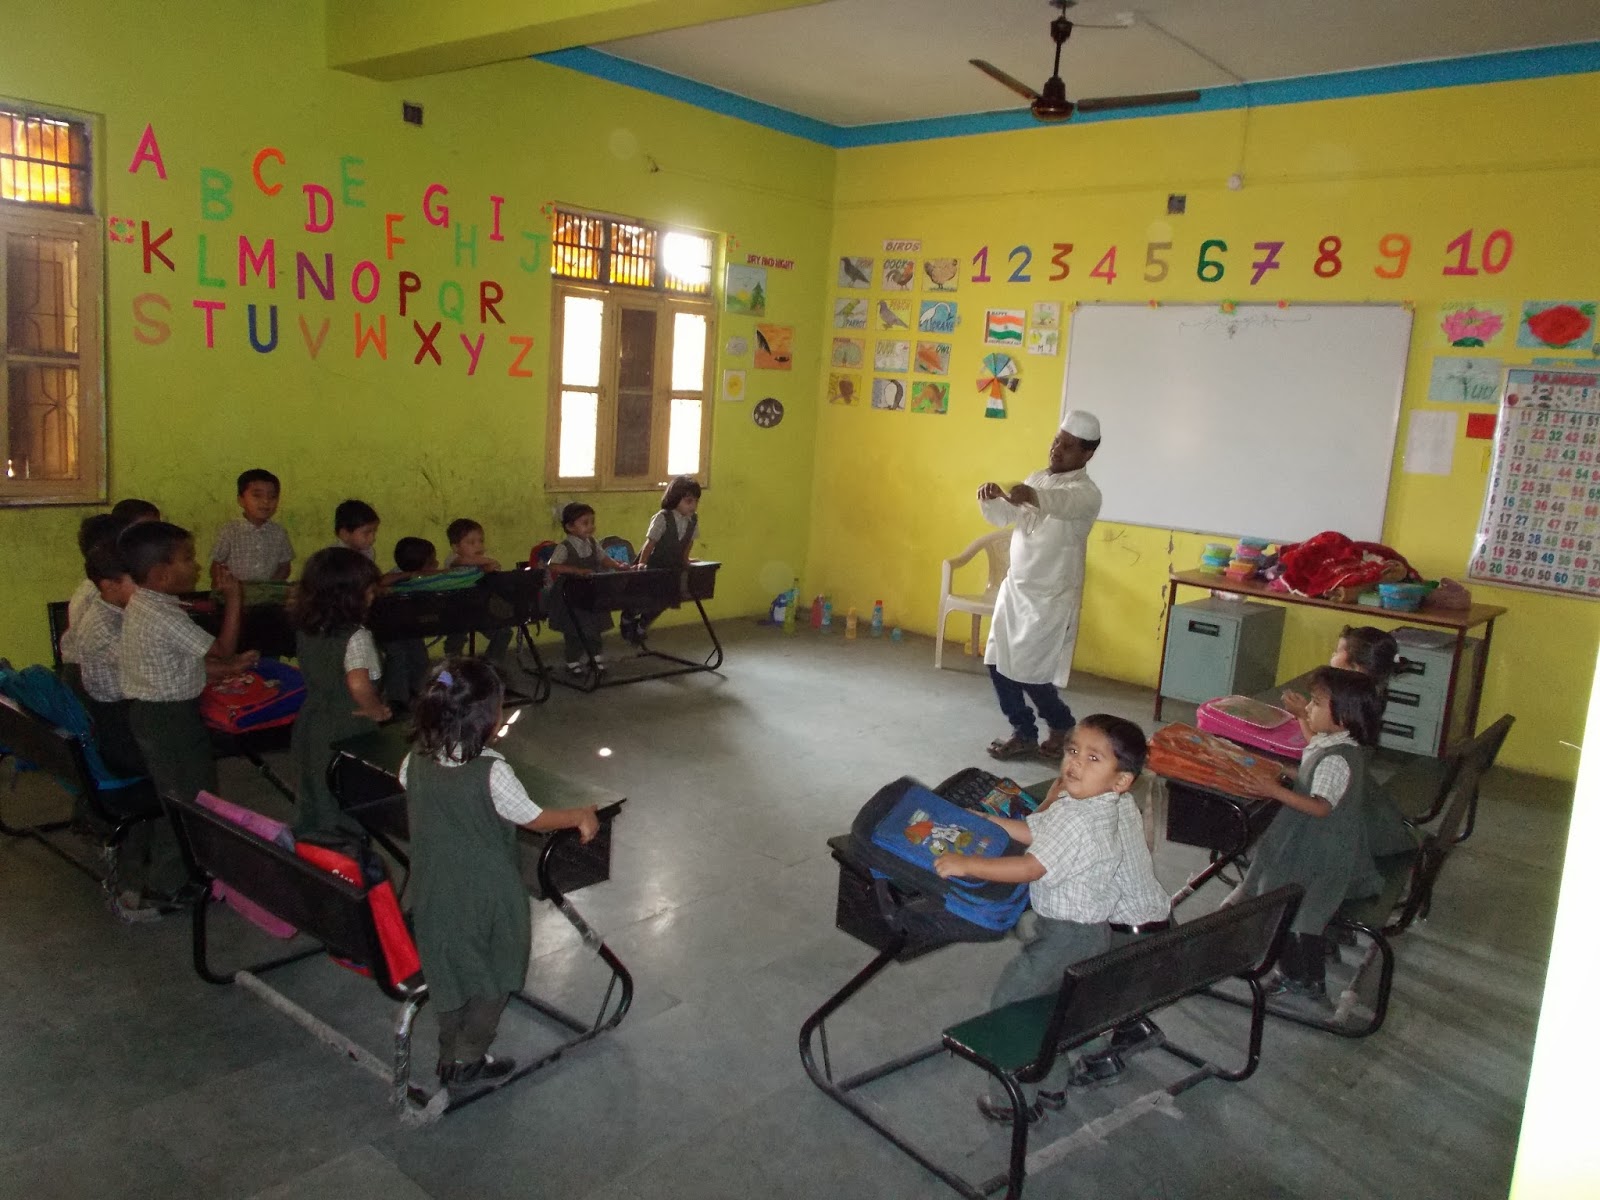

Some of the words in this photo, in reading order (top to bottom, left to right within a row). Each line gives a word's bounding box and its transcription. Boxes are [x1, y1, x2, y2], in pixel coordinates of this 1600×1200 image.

[129, 122, 167, 180] A
[200, 168, 233, 221] B
[253, 147, 285, 196] C
[303, 184, 334, 234] D
[341, 156, 367, 207] E
[385, 214, 405, 260] F
[423, 183, 449, 228] G
[455, 222, 478, 268] H
[490, 195, 505, 241] I
[520, 231, 548, 273] J
[886, 243, 920, 251] BIRDS
[971, 246, 991, 283] 1
[1008, 245, 1032, 282] 2
[1049, 243, 1074, 281] 3
[1089, 246, 1117, 284] 4
[1143, 242, 1173, 283] 5
[1197, 238, 1225, 283] 6
[1250, 241, 1285, 285] 7
[1313, 235, 1343, 279] 8
[1374, 232, 1412, 279] 9
[1442, 228, 1514, 277] 10
[141, 220, 175, 273] K
[199, 234, 226, 288] L
[239, 235, 276, 289] M
[297, 252, 335, 300] N
[351, 260, 380, 304] O
[399, 271, 421, 317] P
[438, 280, 465, 324] Q
[480, 281, 506, 324] R
[132, 293, 171, 345] S
[193, 300, 225, 349] T
[247, 304, 278, 353] U
[299, 315, 330, 360] V
[355, 313, 387, 360] W
[414, 320, 441, 365] X
[508, 336, 533, 378] Z
[1549, 430, 1563, 441] 32
[1513, 445, 1526, 456] 13
[1509, 462, 1522, 473] 14
[1525, 463, 1538, 474] 24
[1503, 496, 1515, 507] 16
[1500, 512, 1512, 523] 17
[1515, 515, 1529, 525] 27
[1528, 533, 1541, 545] 38
[1541, 553, 1554, 564] 49
[1475, 561, 1486, 571] 10
[1489, 563, 1502, 574] 20
[1504, 565, 1518, 576] 30
[1521, 567, 1535, 578] 40
